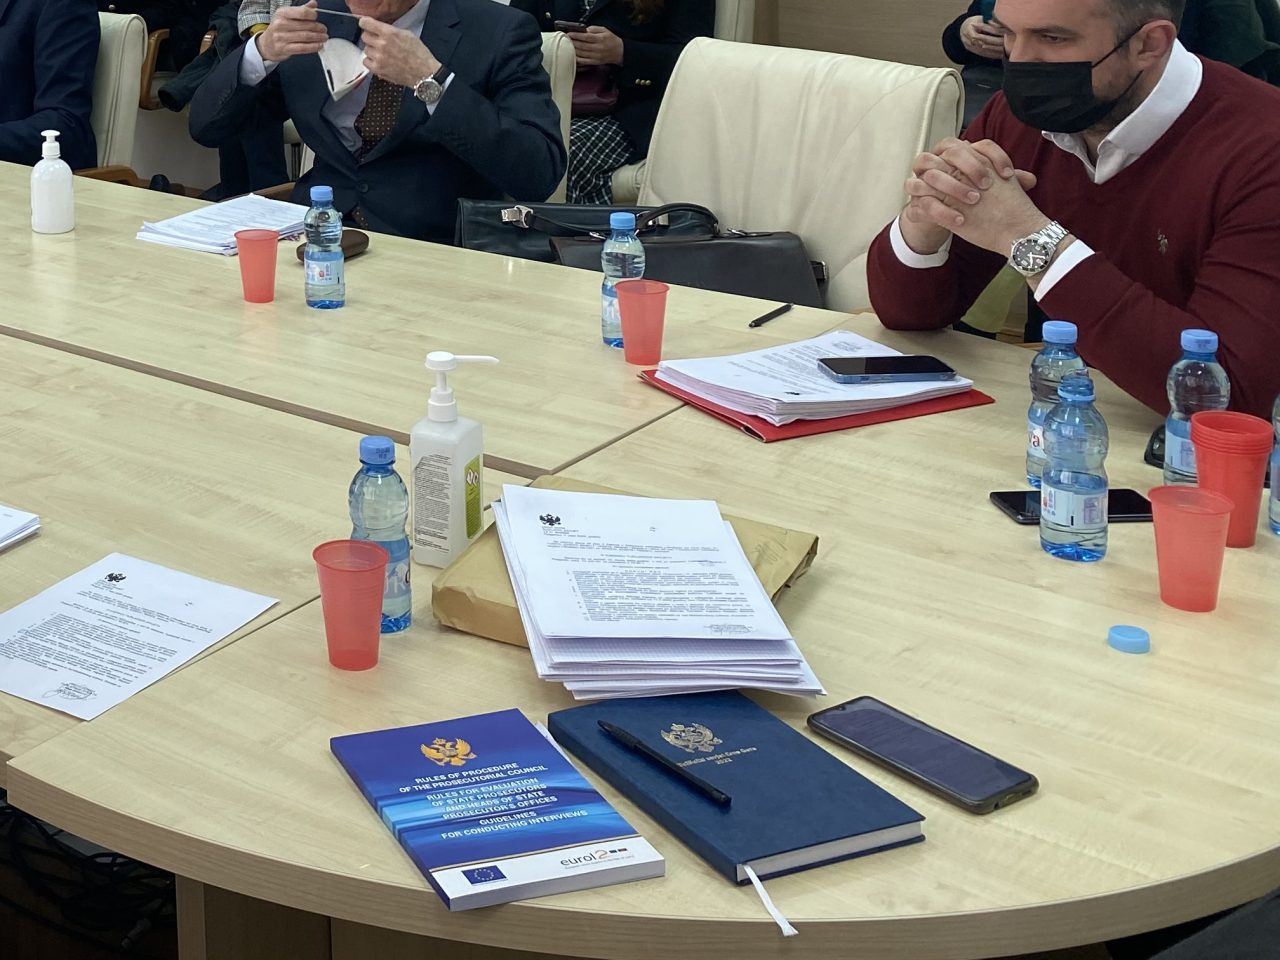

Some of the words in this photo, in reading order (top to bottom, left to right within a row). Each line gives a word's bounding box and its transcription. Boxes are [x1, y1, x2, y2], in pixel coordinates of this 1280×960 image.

[415, 775, 447, 784] RULES
[462, 762, 519, 777] PROCEDURE
[432, 772, 507, 788] PROSECUTORIAL
[508, 765, 548, 776] COUNCIL
[426, 791, 458, 800] RULES
[459, 788, 480, 796] FOR
[481, 777, 539, 792] EVALUATION
[447, 795, 476, 805] STATE
[477, 783, 547, 800] PROSECUTORS
[446, 804, 465, 812] AND
[466, 798, 499, 808] HEADS
[516, 790, 545, 800] STATE
[517, 795, 558, 807] OFFICES
[464, 820, 528, 836] CONDUCTING
[529, 809, 588, 825] INTERVIEWS
[480, 810, 537, 825] GUIDELINES
